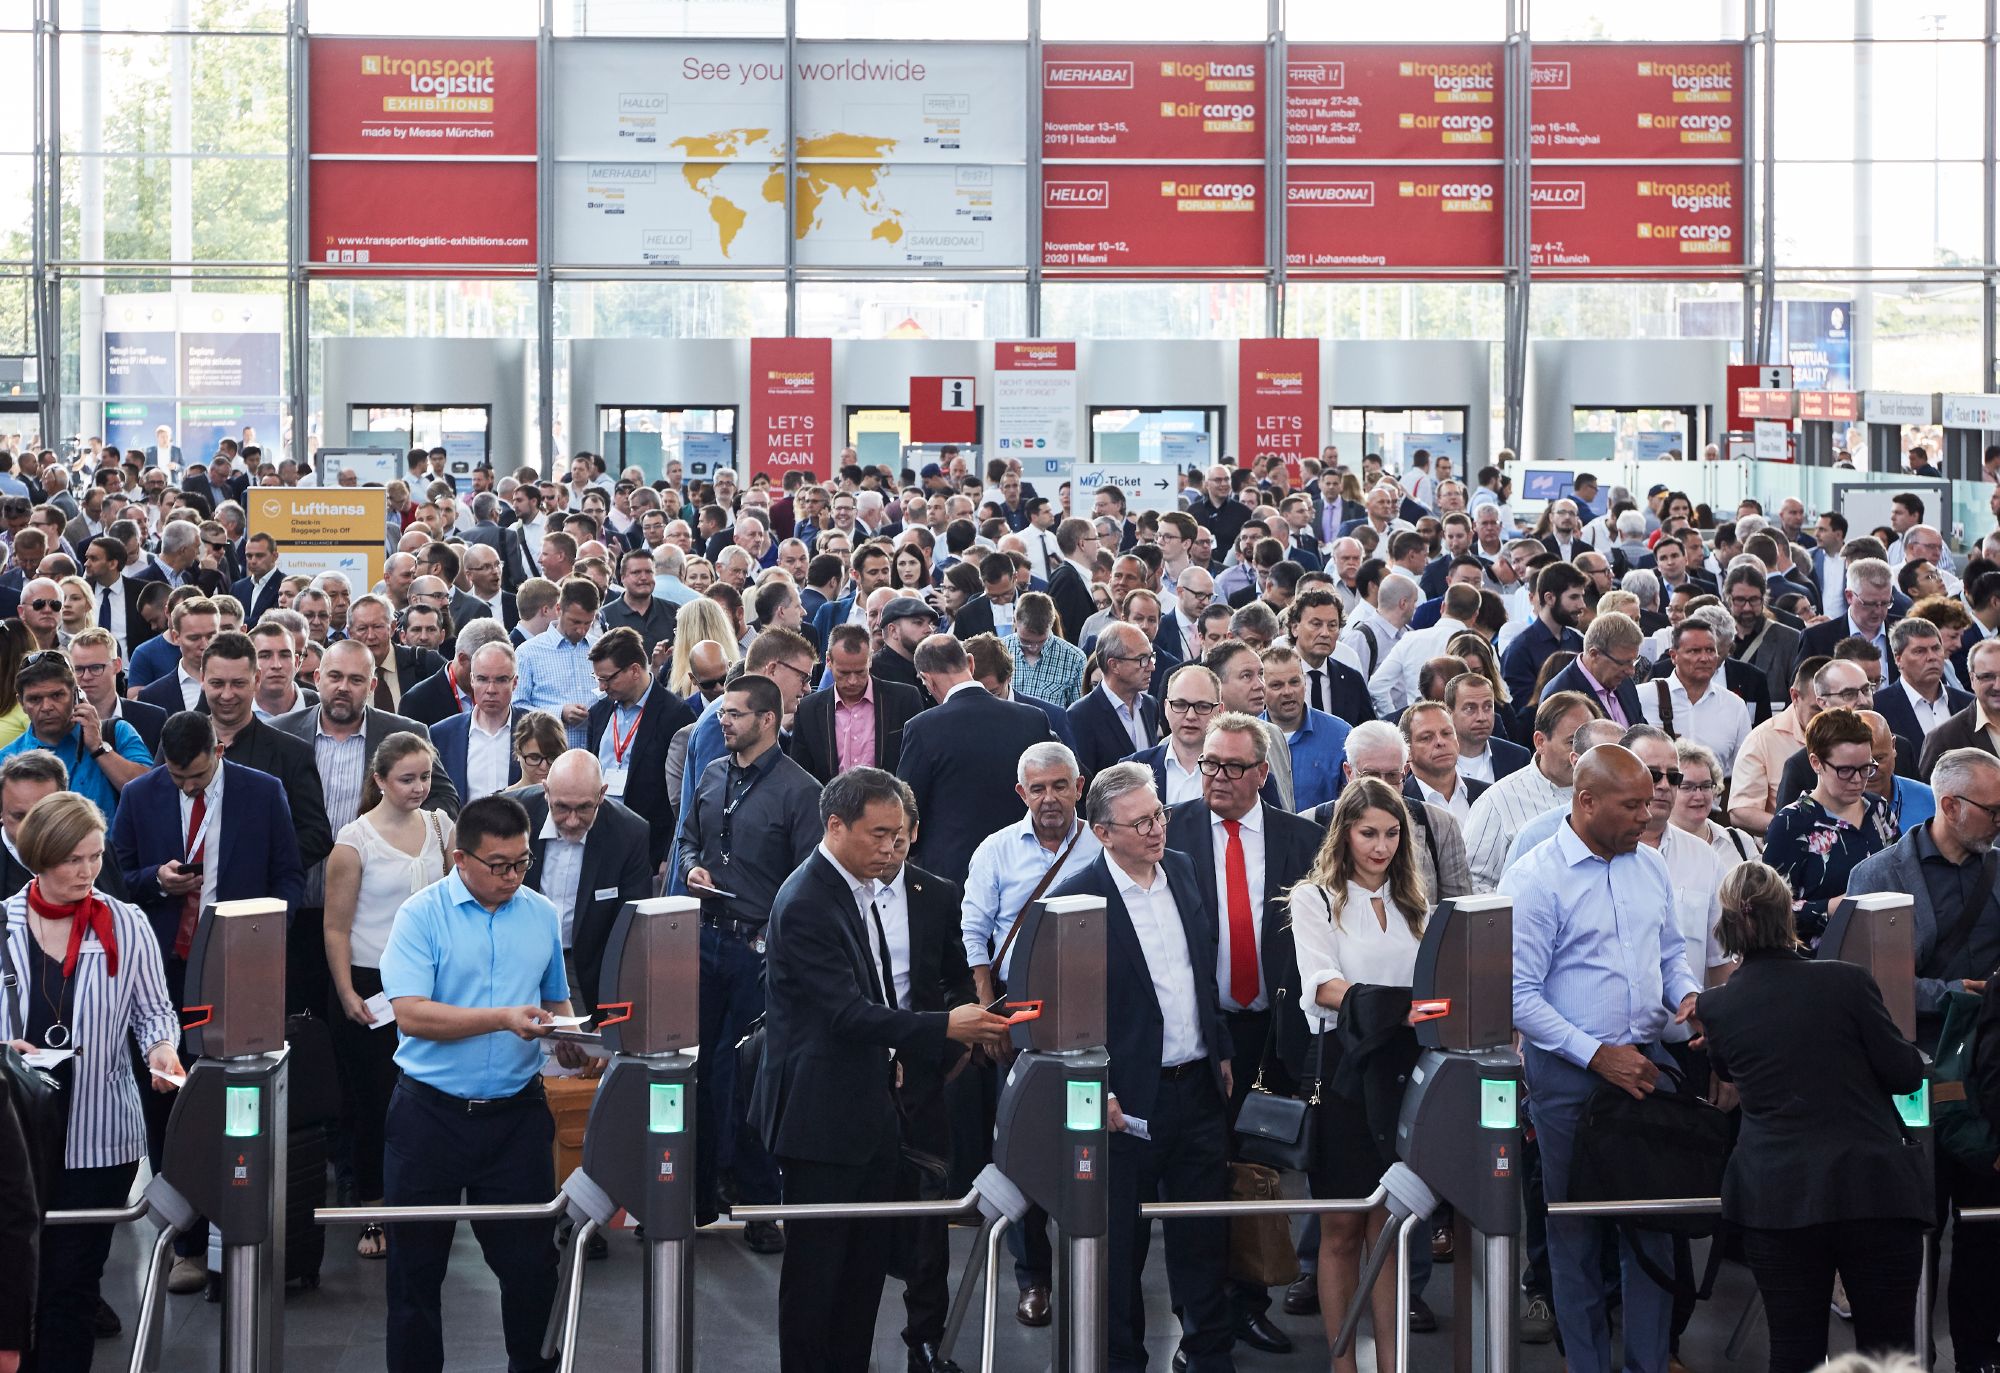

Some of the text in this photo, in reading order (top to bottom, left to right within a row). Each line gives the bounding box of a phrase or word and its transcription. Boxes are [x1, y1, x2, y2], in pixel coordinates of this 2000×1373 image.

[383, 56, 494, 77] transport
[683, 57, 926, 85] See you worldwide
[1176, 61, 1255, 81] logitrans
[1414, 62, 1493, 77] transport
[1652, 62, 1732, 77] transport
[1050, 69, 1127, 82] MERHABA!
[411, 73, 494, 98] logistic
[1434, 74, 1493, 93] logistic
[1672, 73, 1732, 92] logistic
[1448, 92, 1479, 101] INDIA
[1685, 91, 1719, 101] CHINA
[387, 98, 489, 111] EXHIBITIONS
[623, 99, 664, 108] HALLO!
[1177, 102, 1255, 122] air cargo
[1315, 108, 1356, 118] Mumbai
[1045, 122, 1095, 132] November
[1415, 115, 1494, 133] air cargo
[1653, 115, 1732, 132] air cargo
[362, 128, 494, 140] made by Messe München
[1045, 135, 1116, 144] 2019 Istanbul
[1315, 134, 1356, 144] Mumbai
[1451, 132, 1482, 141] INDIA
[1554, 134, 1601, 146] Shanghai
[1688, 132, 1723, 141] CHINA
[591, 168, 651, 178] MERHABA!
[1050, 188, 1104, 201] HELLO!
[1177, 183, 1256, 201] air cargo
[1287, 188, 1369, 200] SAWUBONA!
[1415, 183, 1493, 201] air cargo
[1652, 181, 1731, 197] transport
[1446, 201, 1487, 210] AFRICA
[1672, 192, 1732, 213] logistic
[647, 236, 688, 245] HELLO!
[1653, 225, 1731, 243] air cargo
[338, 236, 528, 247] www.transportlogistic-exhibitions.com
[910, 236, 978, 246] SAWUBONA!
[1045, 242, 1095, 251] November
[1045, 254, 1107, 263] 2020 Miami
[1286, 254, 1386, 265] 021 Johannesburg
[1553, 254, 1591, 263] Munich
[1789, 351, 1829, 366] VIRTUAL
[1793, 367, 1829, 383] EALITY
[768, 416, 814, 429] LET'S
[1256, 416, 1302, 430] LET'S
[768, 434, 814, 447] MEET
[1256, 433, 1302, 447] MEET
[767, 452, 814, 465] AGAIN
[1259, 452, 1302, 465] AIN
[291, 502, 365, 515] Lufthansa
